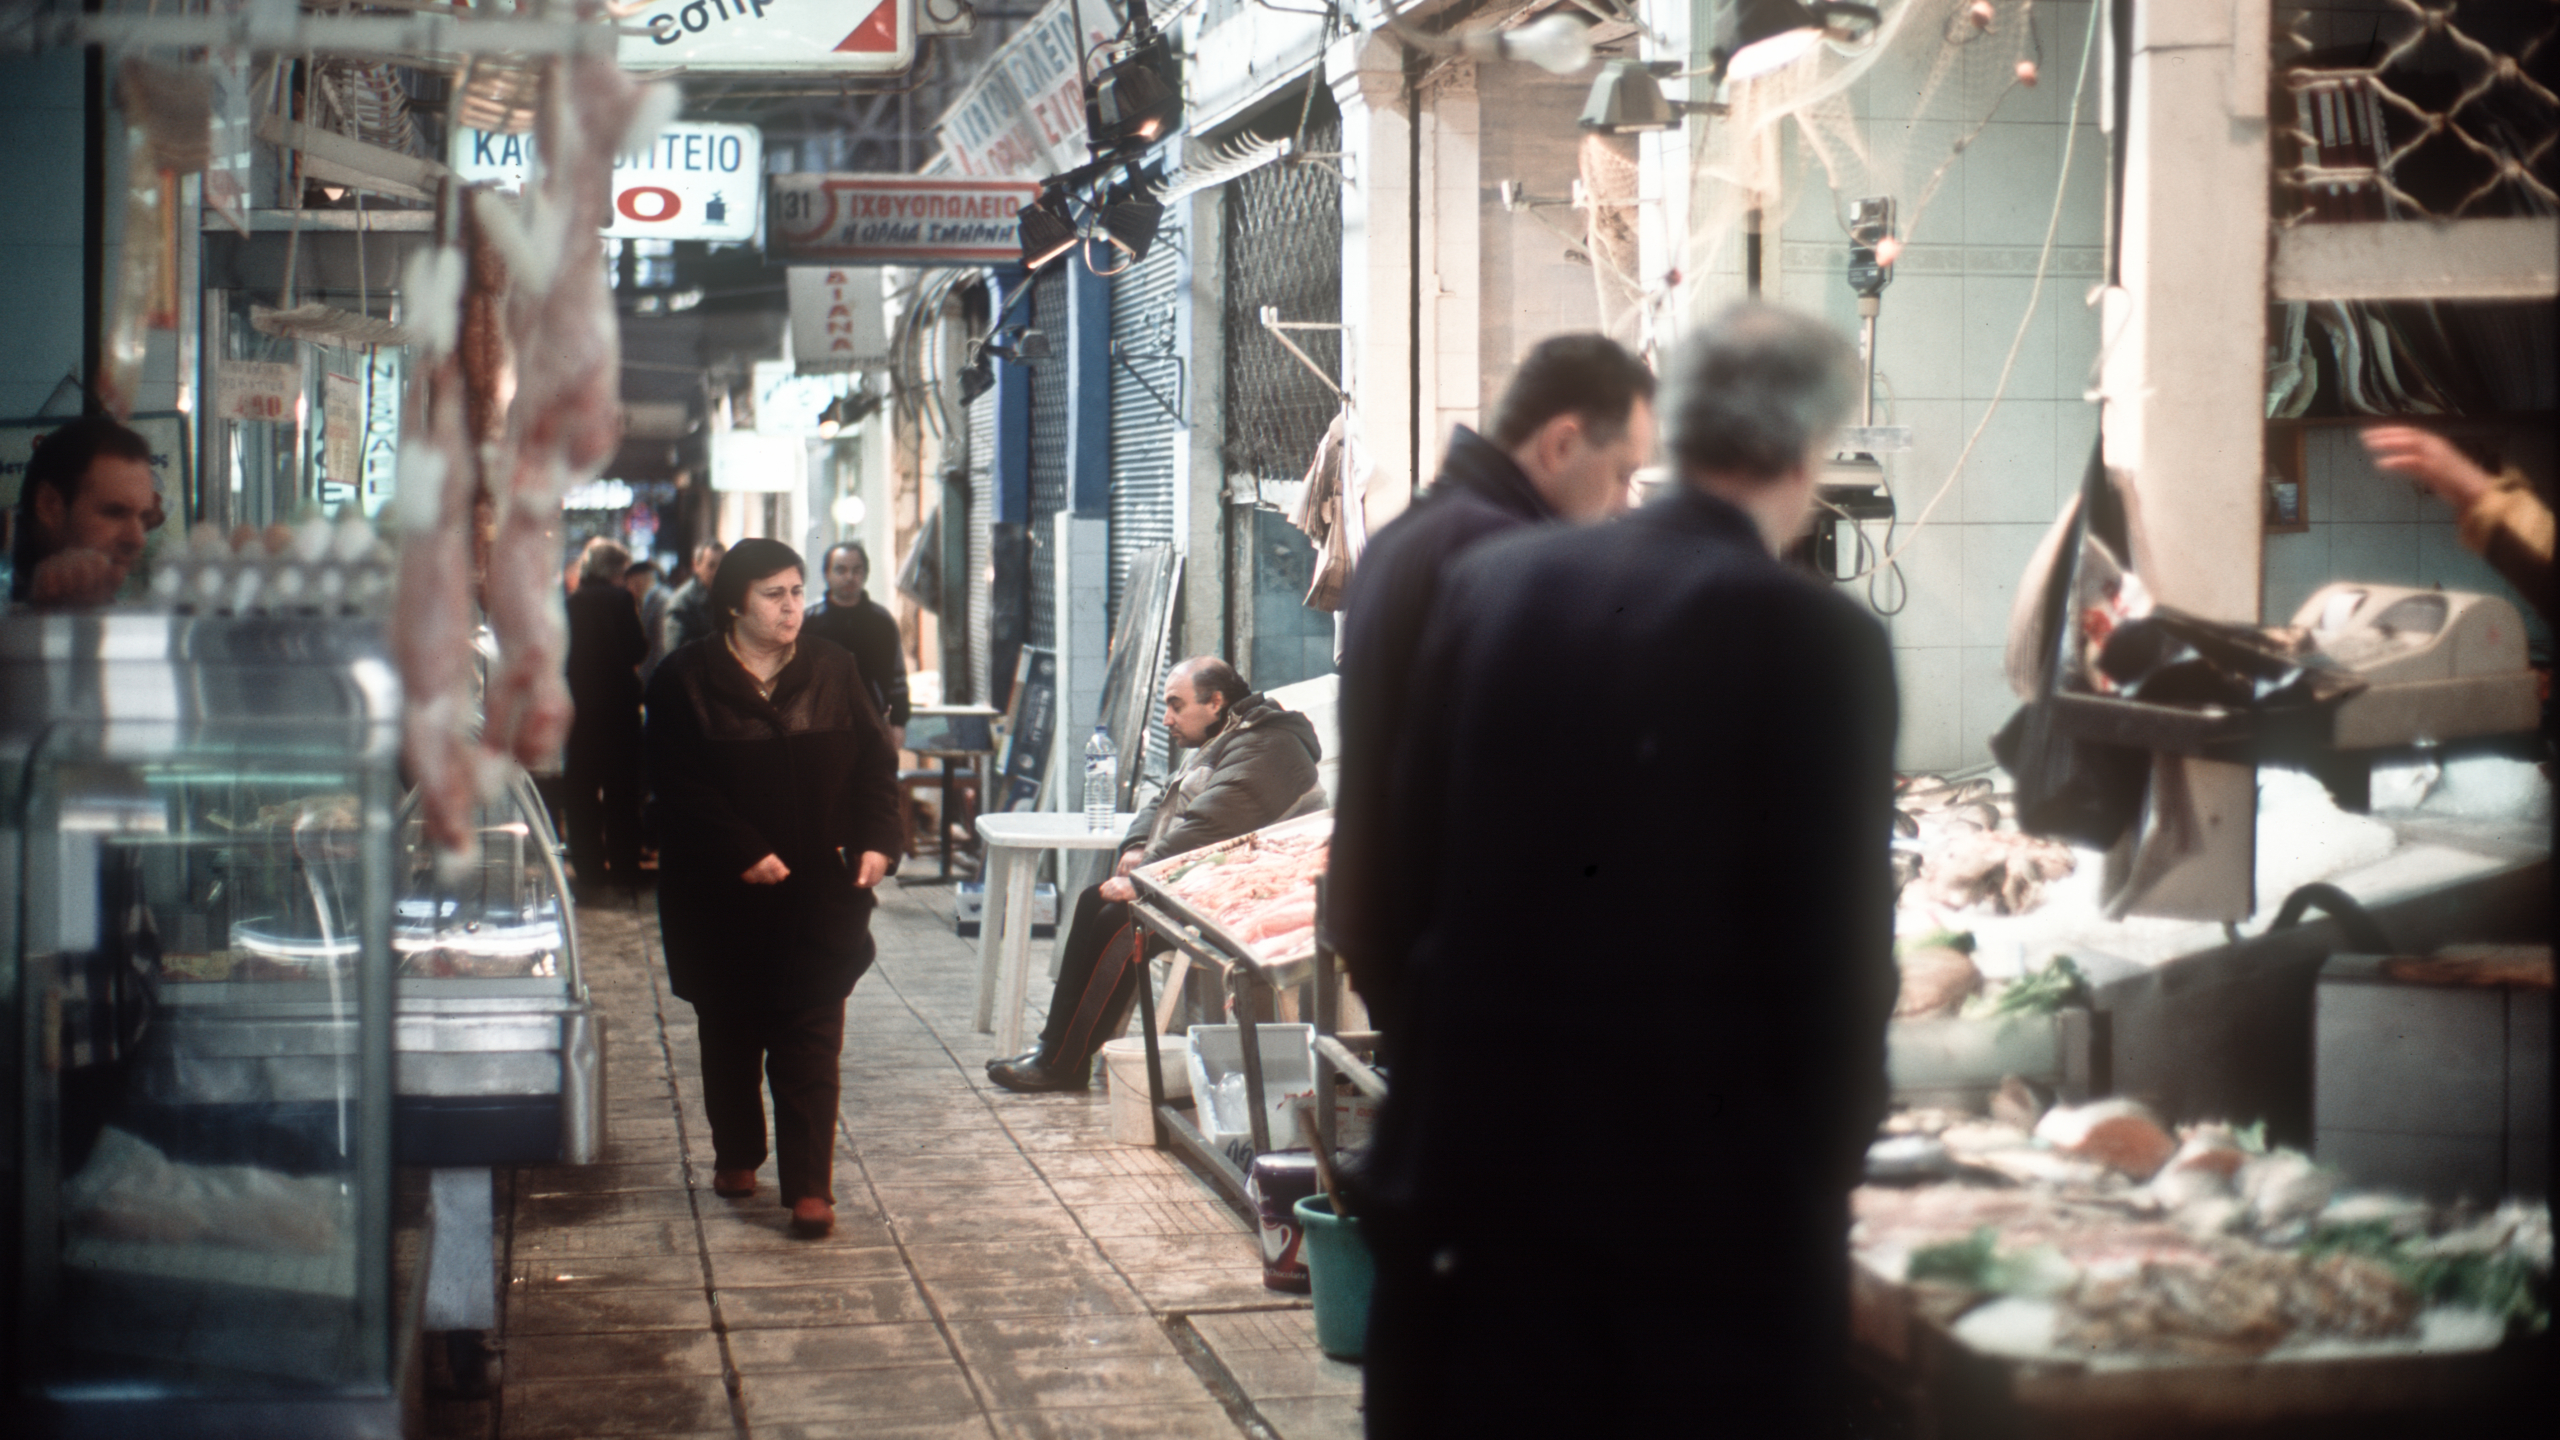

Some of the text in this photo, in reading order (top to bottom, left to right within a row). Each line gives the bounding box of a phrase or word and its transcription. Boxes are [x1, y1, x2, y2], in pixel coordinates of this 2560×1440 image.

[777, 191, 811, 220] 131
[851, 193, 1020, 218] ΙΧΘΥΟΠΩΛΕΙΟ
[861, 222, 922, 244] ΩΡΑΙΑ
